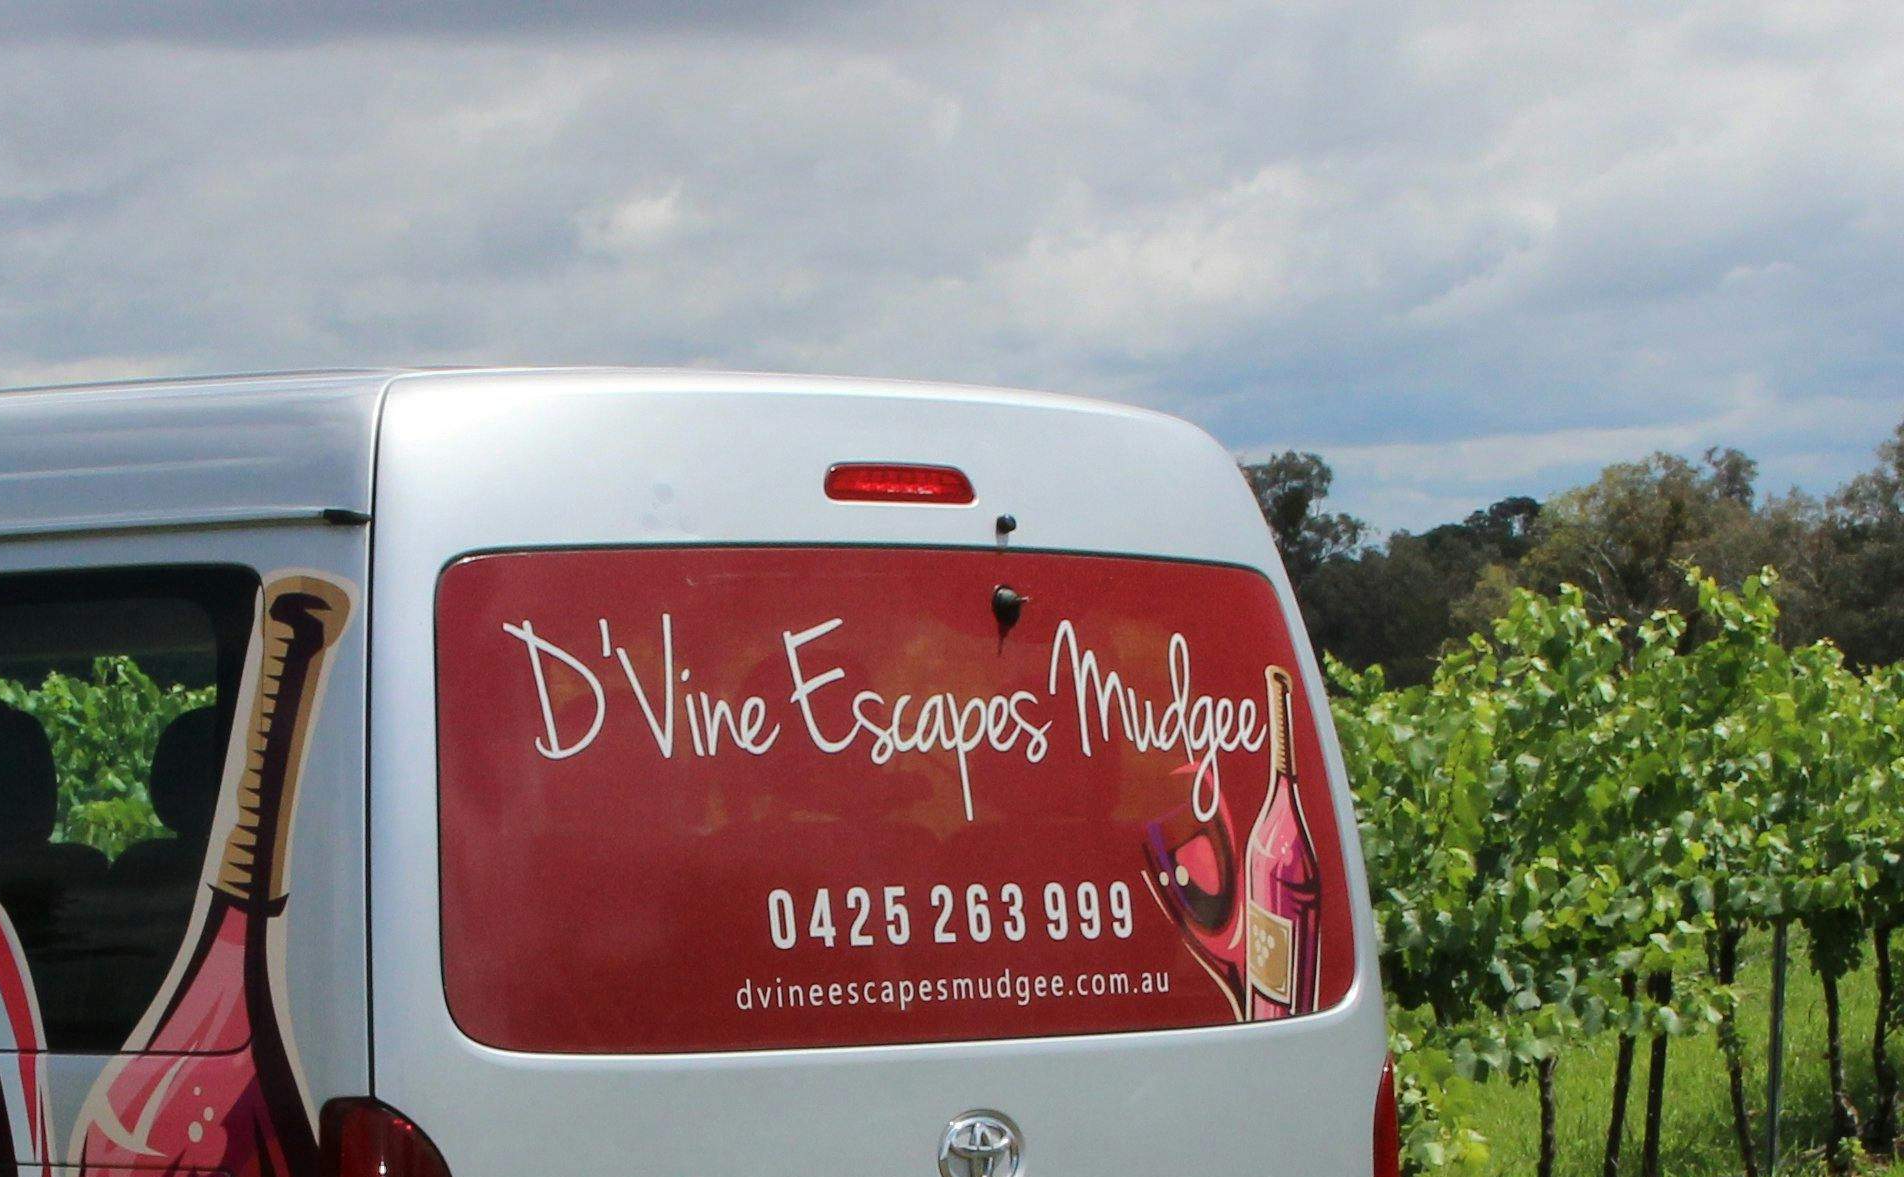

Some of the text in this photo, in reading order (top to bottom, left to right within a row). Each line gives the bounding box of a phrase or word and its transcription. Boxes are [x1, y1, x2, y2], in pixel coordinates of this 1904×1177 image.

[502, 612, 1267, 822] D'Vine Escapes Mudgee
[767, 880, 1134, 950] 0425 263 999
[735, 966, 1170, 1013] dvineescapesmudgee.com.au
